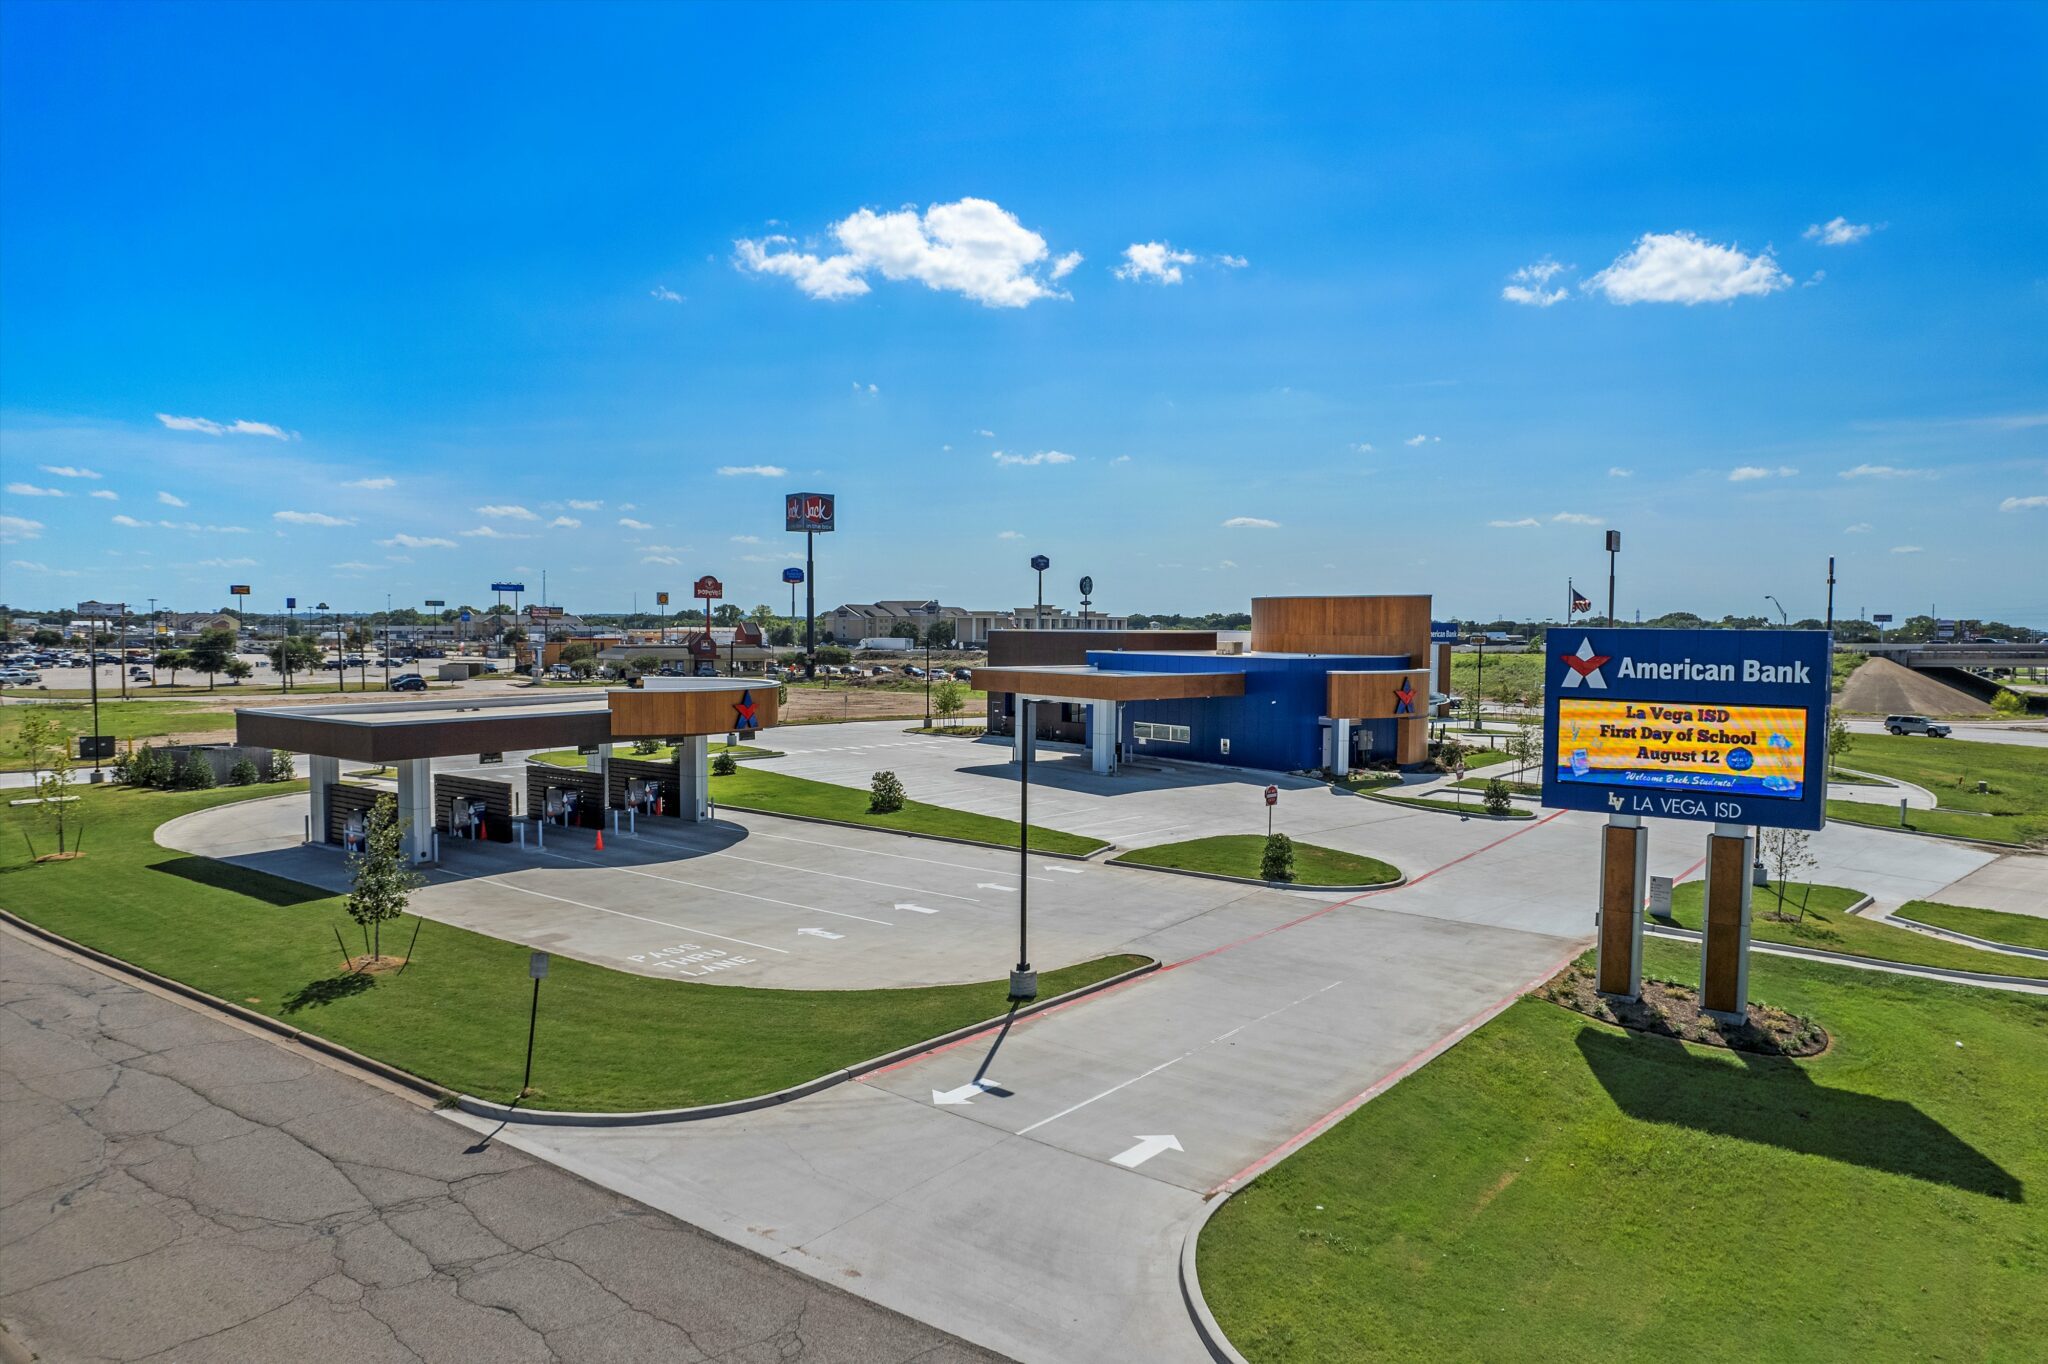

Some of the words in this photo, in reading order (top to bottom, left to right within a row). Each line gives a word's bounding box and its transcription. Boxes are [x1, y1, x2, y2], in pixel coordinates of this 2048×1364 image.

[805, 499, 833, 521] Jack
[1617, 657, 1735, 682] American
[1743, 659, 1811, 684] Bank
[1626, 706, 1645, 719] La
[1650, 706, 1693, 724] Vega
[1698, 709, 1730, 723] ISD
[1600, 725, 1637, 739] First
[1640, 726, 1673, 744] Day
[1677, 727, 1693, 742] of
[1697, 730, 1757, 746] School
[1636, 746, 1697, 763] August
[1701, 750, 1720, 764] 12
[1625, 771, 1664, 784] Welcome
[1692, 775, 1736, 788] Students!
[1633, 796, 1653, 812] LA
[1660, 798, 1707, 816] VEGA
[1715, 802, 1742, 819] ISD
[627, 943, 702, 963] PASS
[653, 949, 727, 968] THRU
[679, 955, 757, 977] LANE
